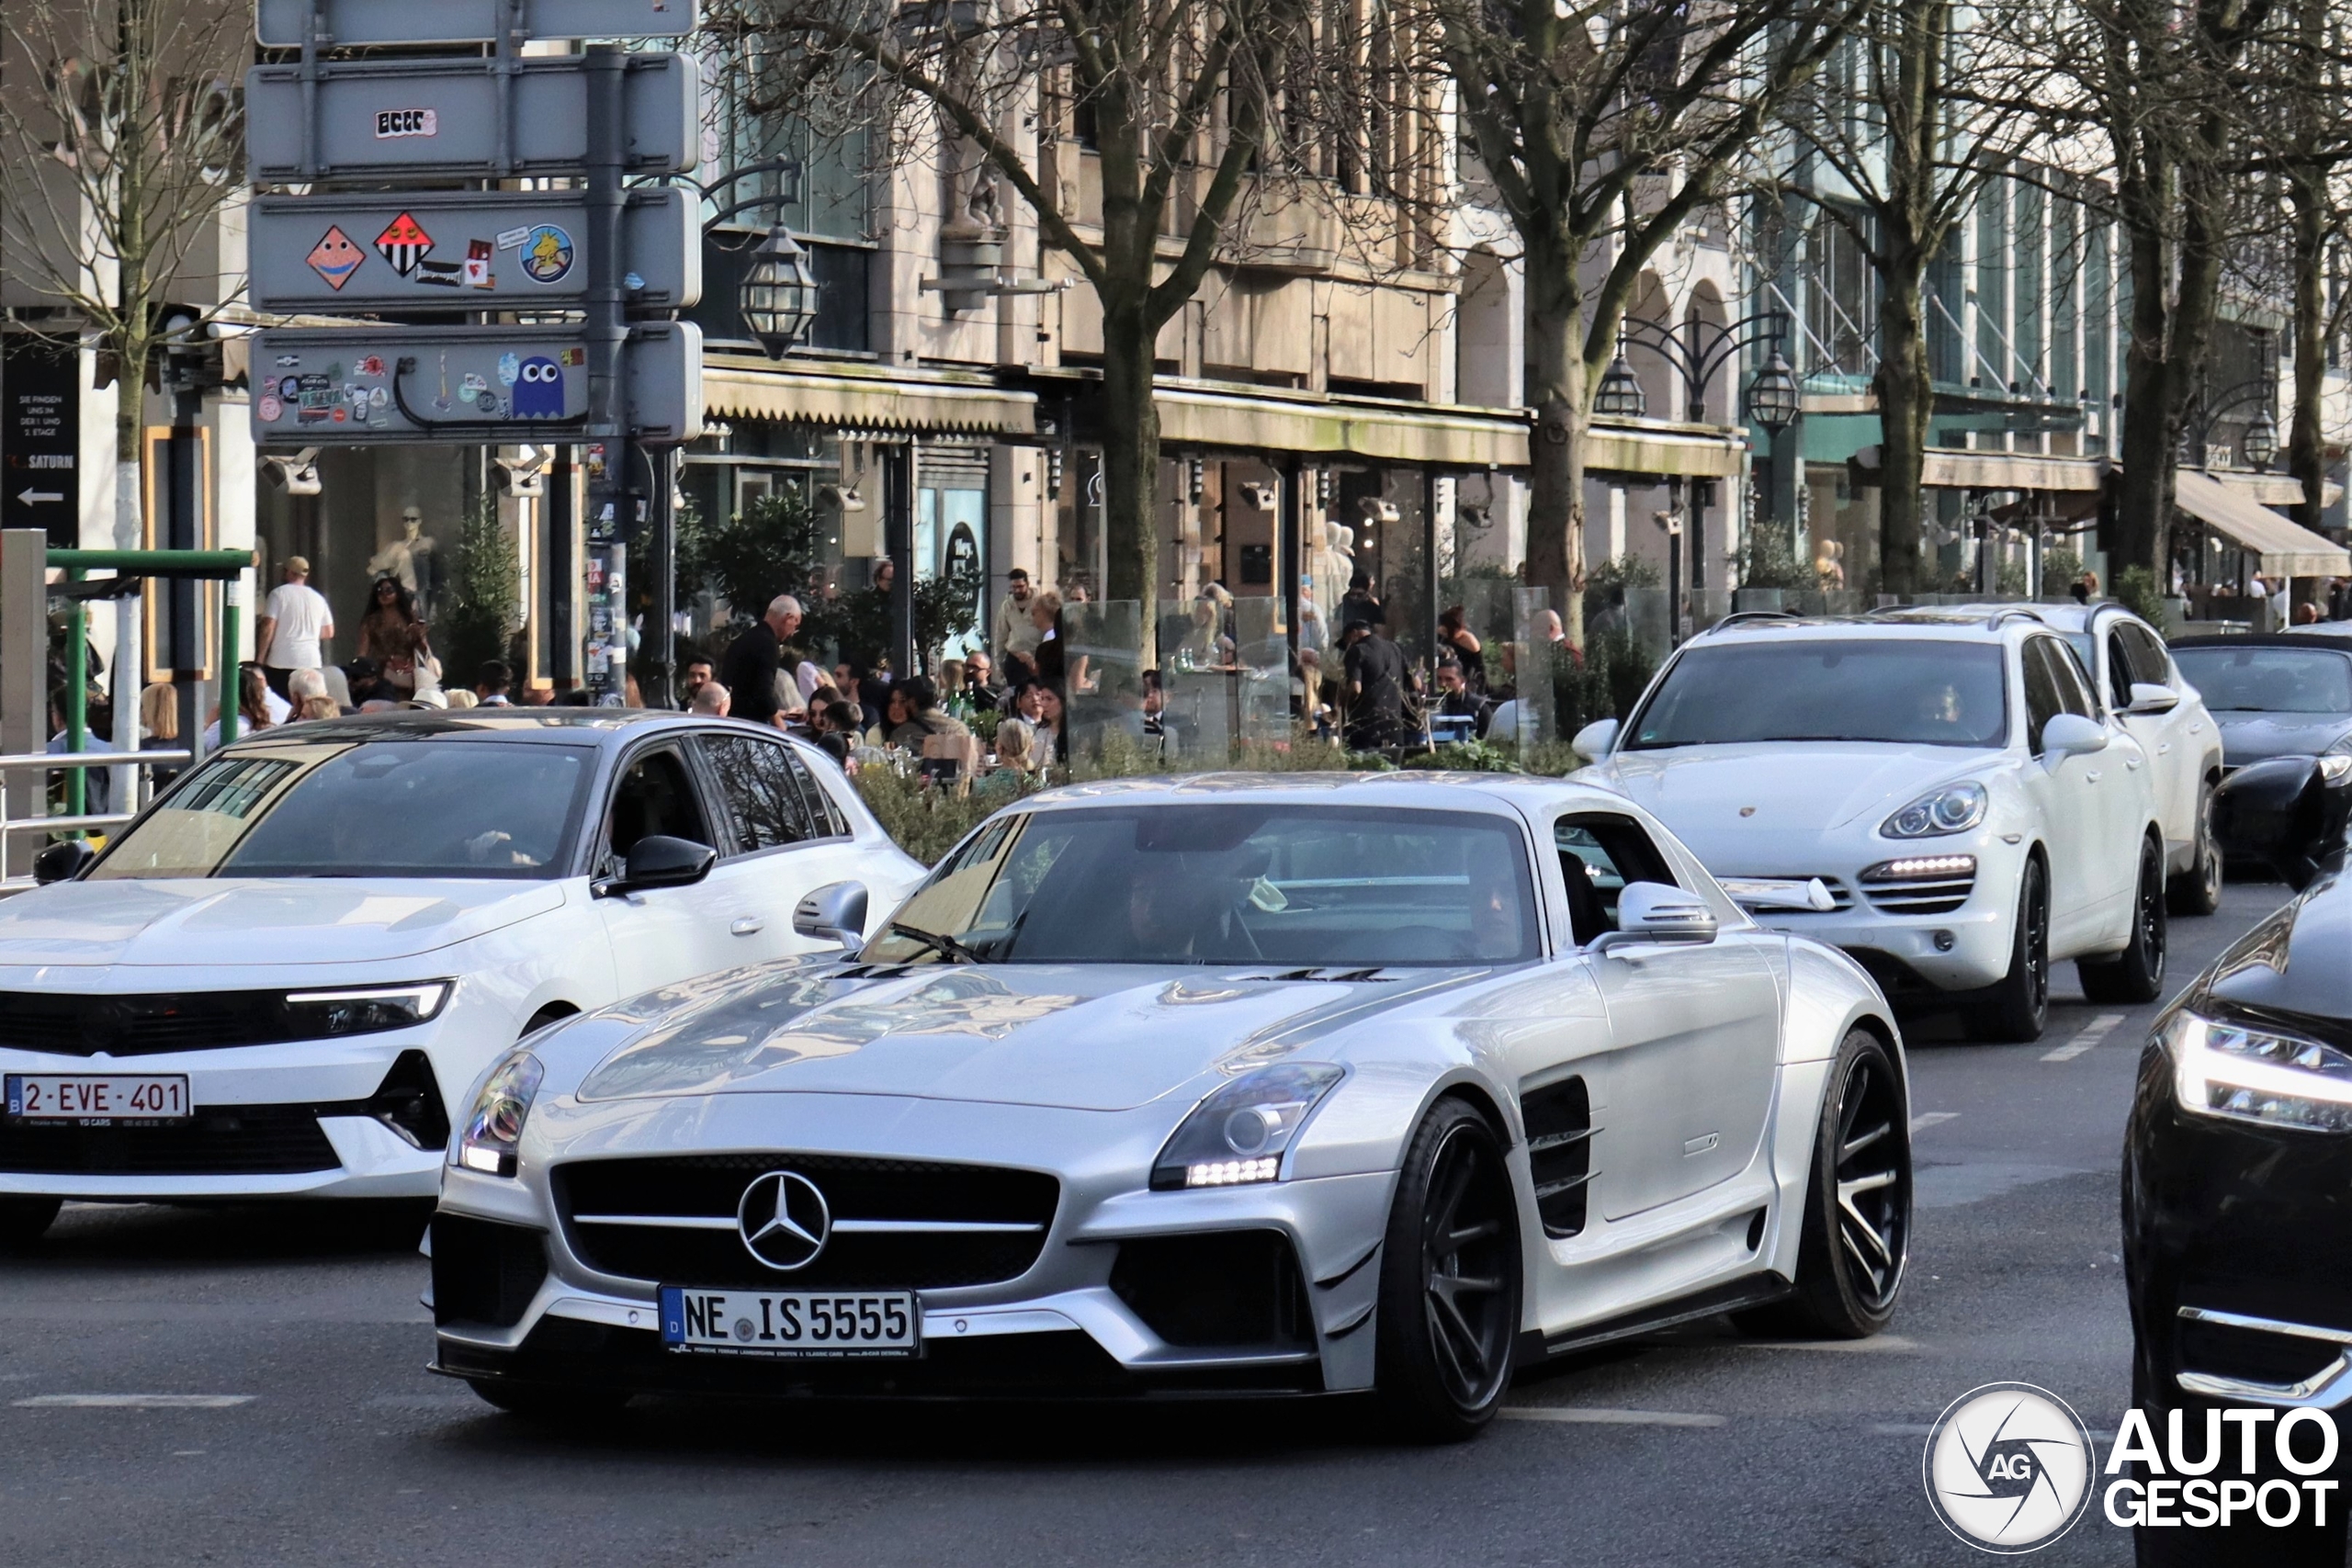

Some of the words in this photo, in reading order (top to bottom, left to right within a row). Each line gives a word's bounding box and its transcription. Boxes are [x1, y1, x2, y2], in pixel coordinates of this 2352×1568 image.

[19, 396, 31, 404] SIE
[32, 428, 56, 436] ETAGE
[28, 455, 74, 468] SATURN
[8, 1100, 20, 1113] B
[670, 1321, 679, 1333] D
[685, 1295, 729, 1338] NE
[759, 1298, 801, 1341] IS
[810, 1298, 907, 1341] 5555
